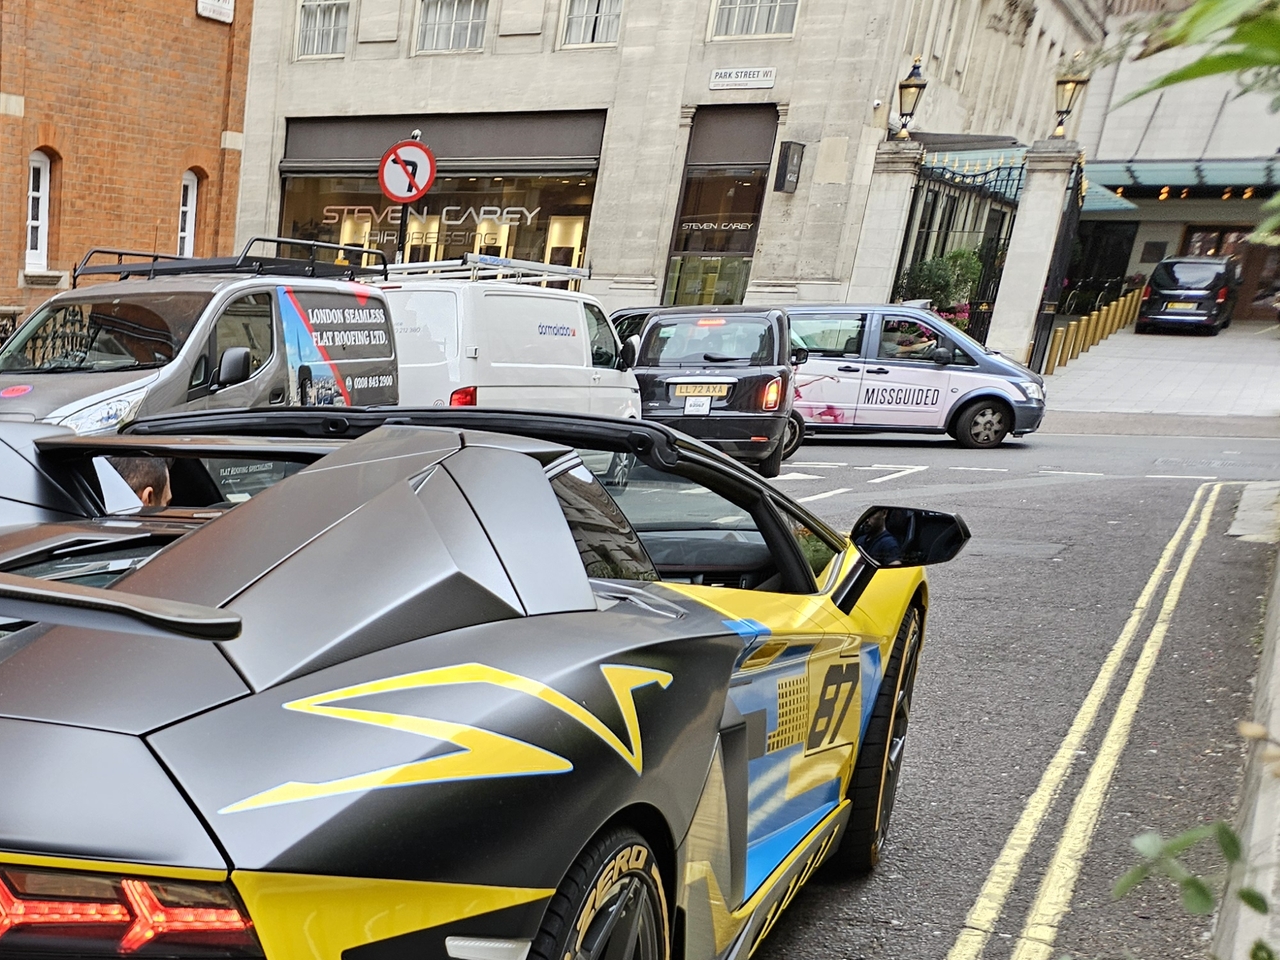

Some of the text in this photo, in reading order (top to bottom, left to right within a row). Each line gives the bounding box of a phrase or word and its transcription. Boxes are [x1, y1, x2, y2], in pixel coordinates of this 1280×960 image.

[714, 70, 773, 79] PARK STREET W1
[322, 206, 541, 226] STEVEN CAREY
[682, 222, 754, 230] STEVEN CAREY
[308, 308, 386, 324] LONDON SEAMLESS
[538, 322, 571, 337] dormakaba
[312, 331, 334, 346] FLAT
[334, 330, 370, 346] ROOFING
[370, 330, 388, 345] LTD.
[679, 385, 724, 394] LL72 AXA
[863, 387, 940, 406] MISSGUIDED
[806, 662, 861, 751] 87
[575, 844, 648, 953] ZERO
